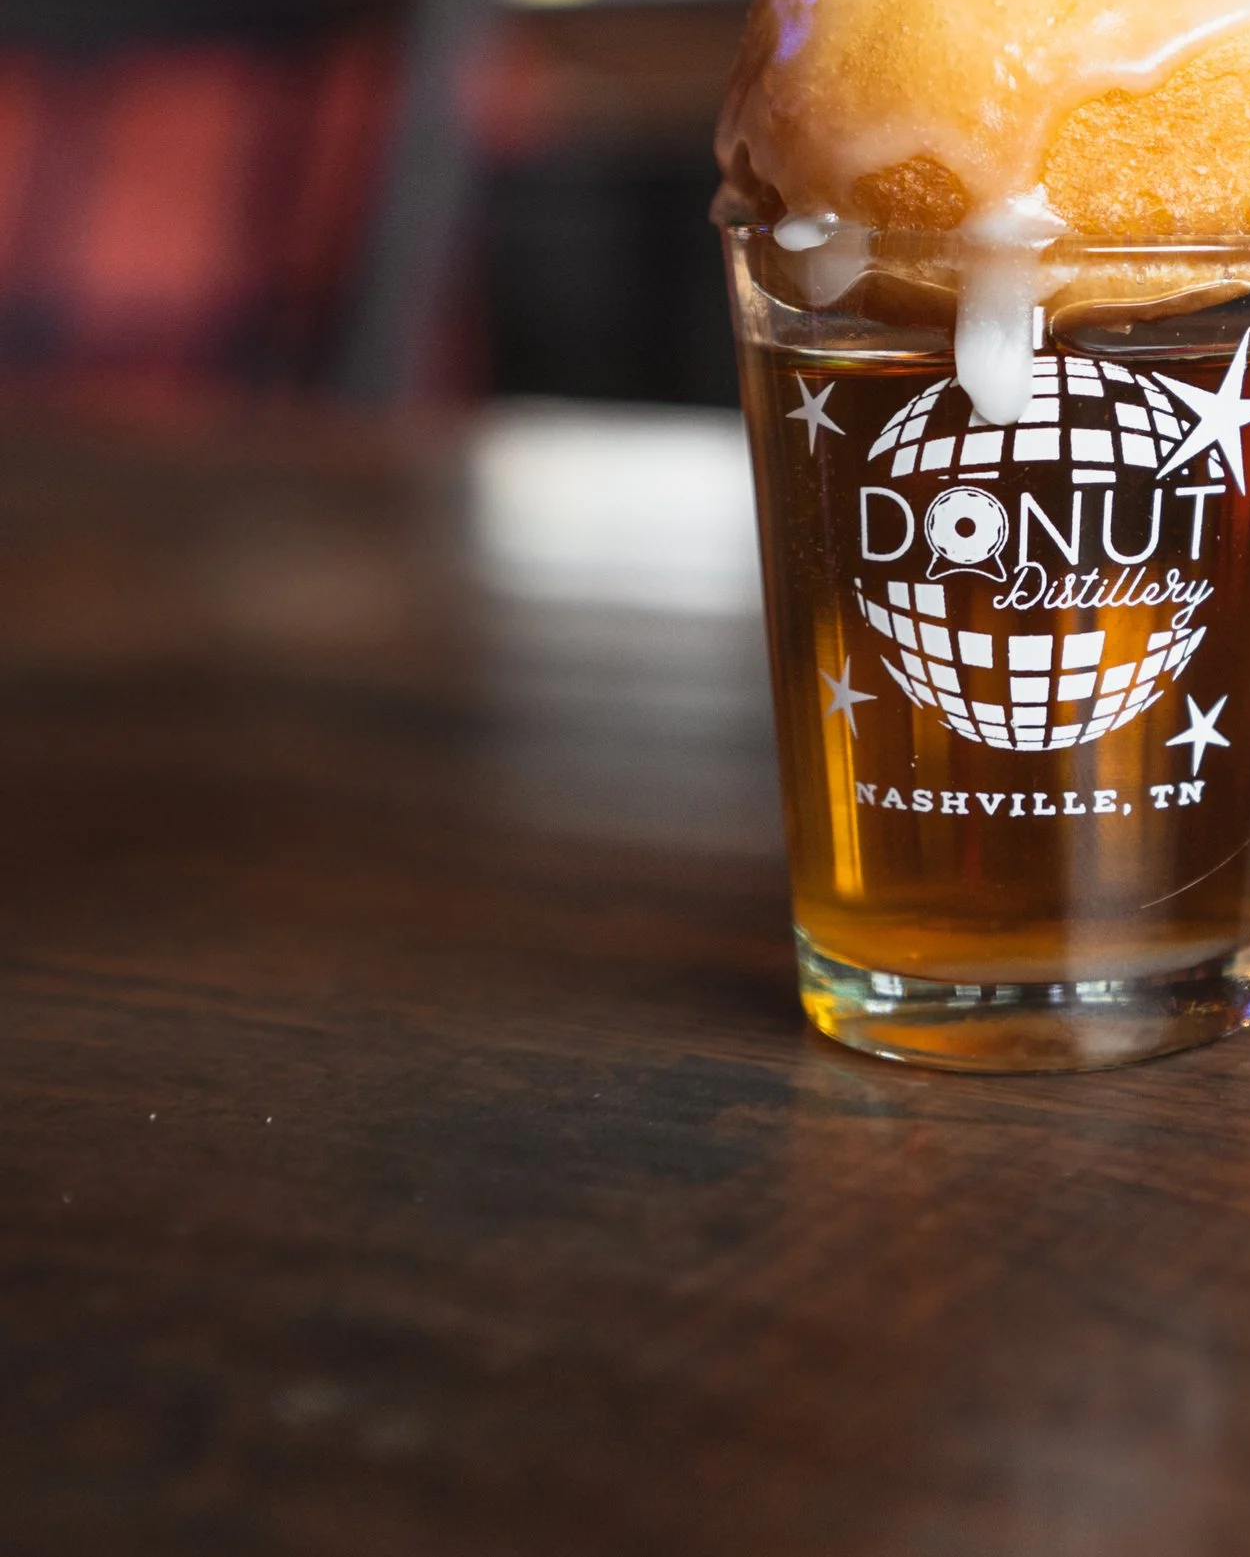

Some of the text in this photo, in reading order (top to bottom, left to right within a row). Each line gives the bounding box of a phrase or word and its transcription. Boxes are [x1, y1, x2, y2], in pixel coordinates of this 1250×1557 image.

[860, 485, 1226, 568] DONUT
[993, 561, 1214, 629] Distillery
[855, 780, 1206, 816] NASHVILLE, TN
